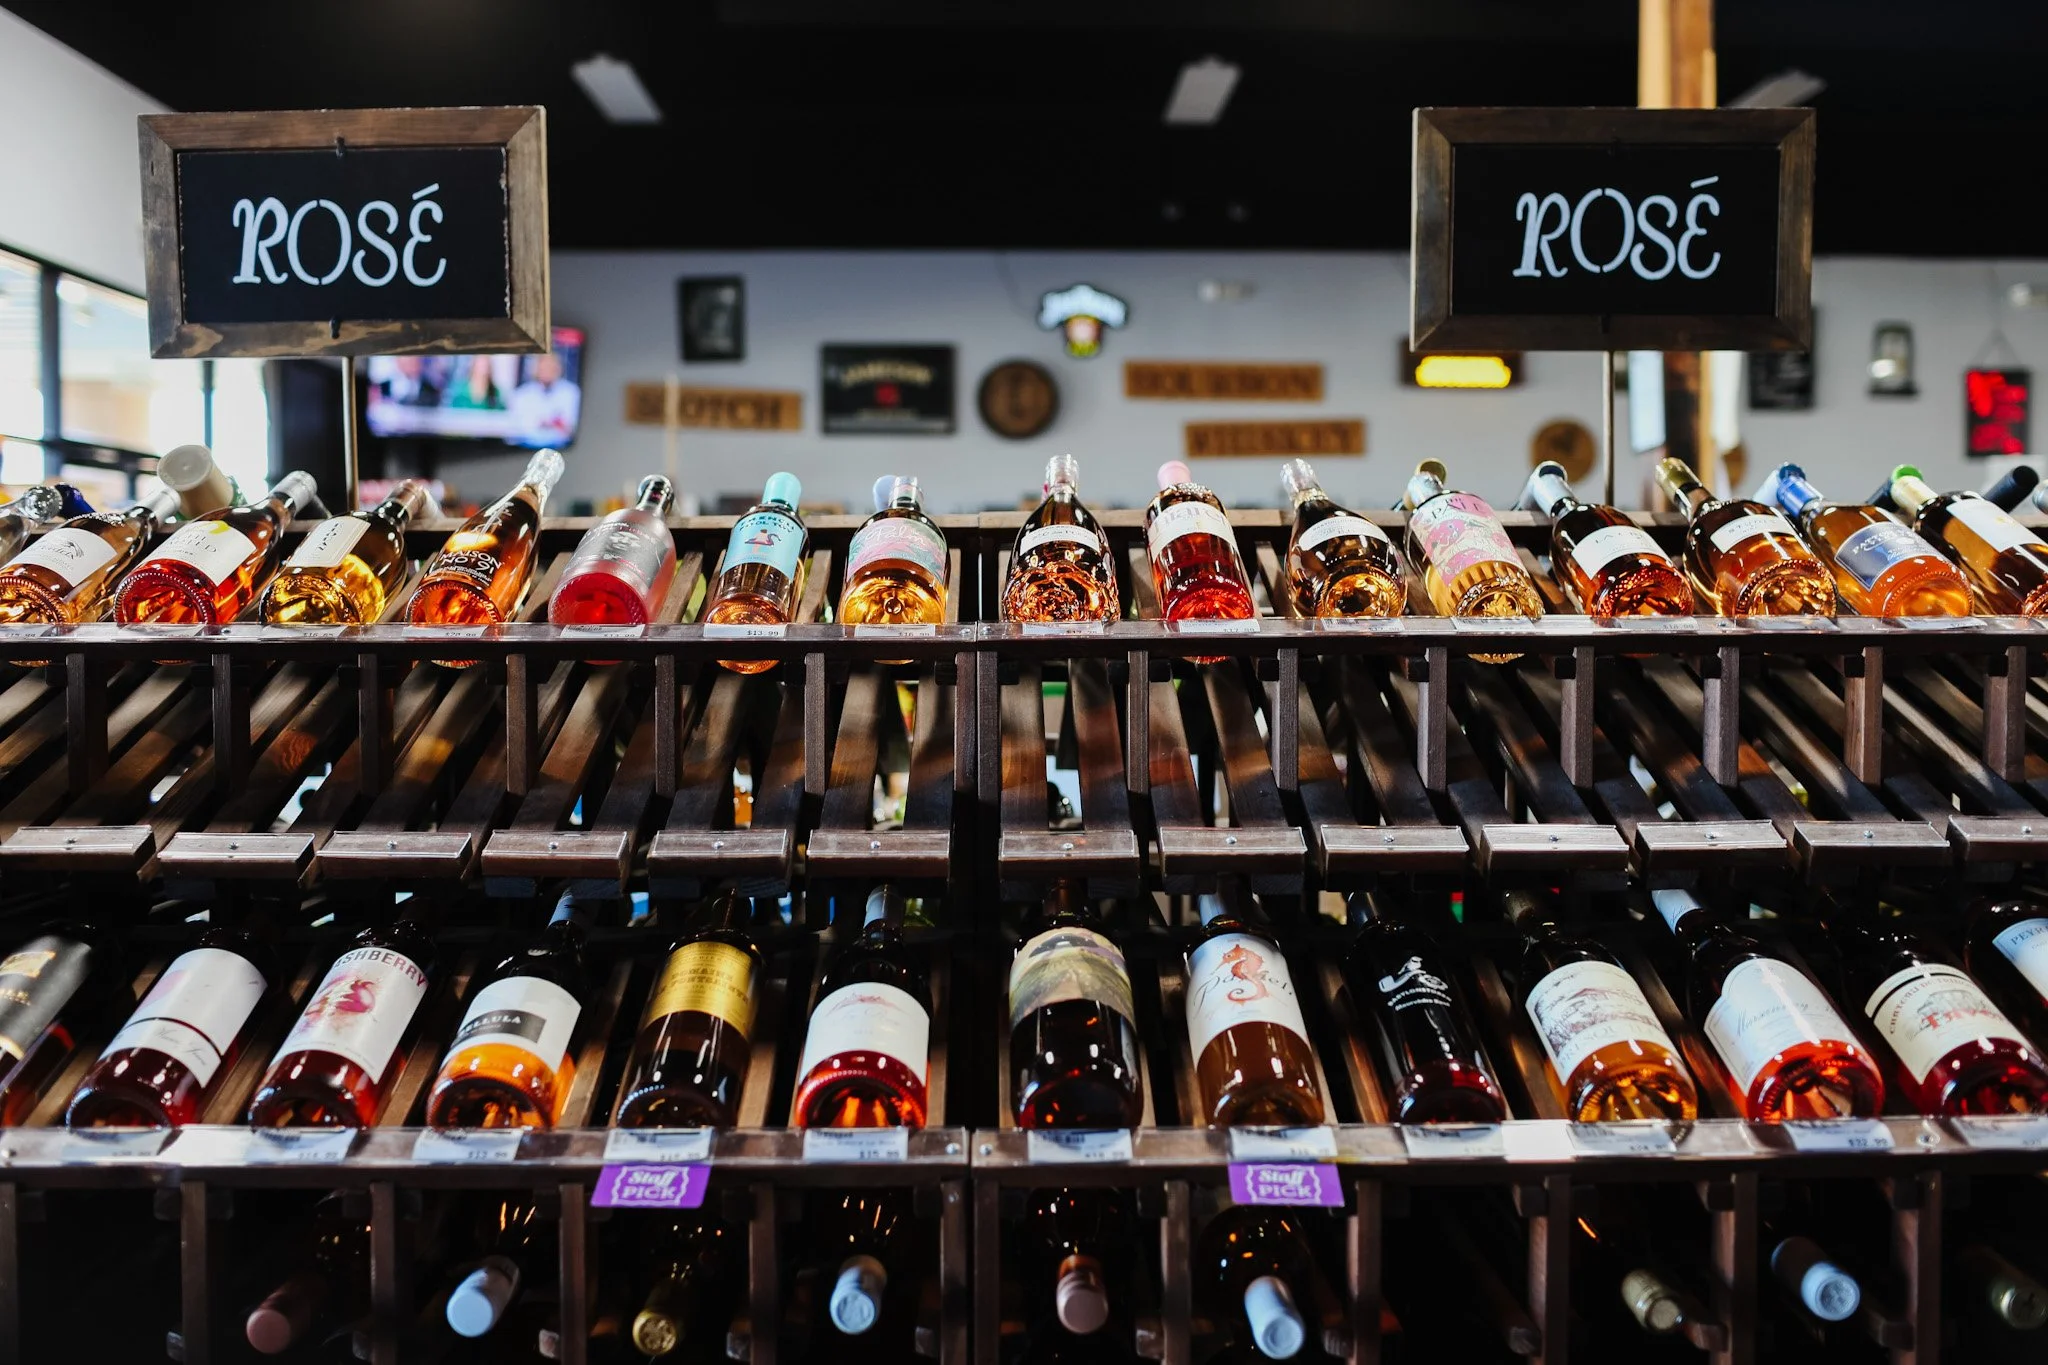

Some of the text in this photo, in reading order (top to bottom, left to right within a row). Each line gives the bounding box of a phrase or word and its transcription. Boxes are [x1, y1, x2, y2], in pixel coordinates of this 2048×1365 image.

[232, 182, 448, 288] ROSÉ
[1512, 175, 1722, 281] ROSÉ
[440, 549, 501, 569] MAISON
[627, 1169, 677, 1187] Staff
[1258, 1169, 1308, 1187] Staff
[621, 1186, 676, 1200] PICK
[1256, 1184, 1312, 1199] PICK
